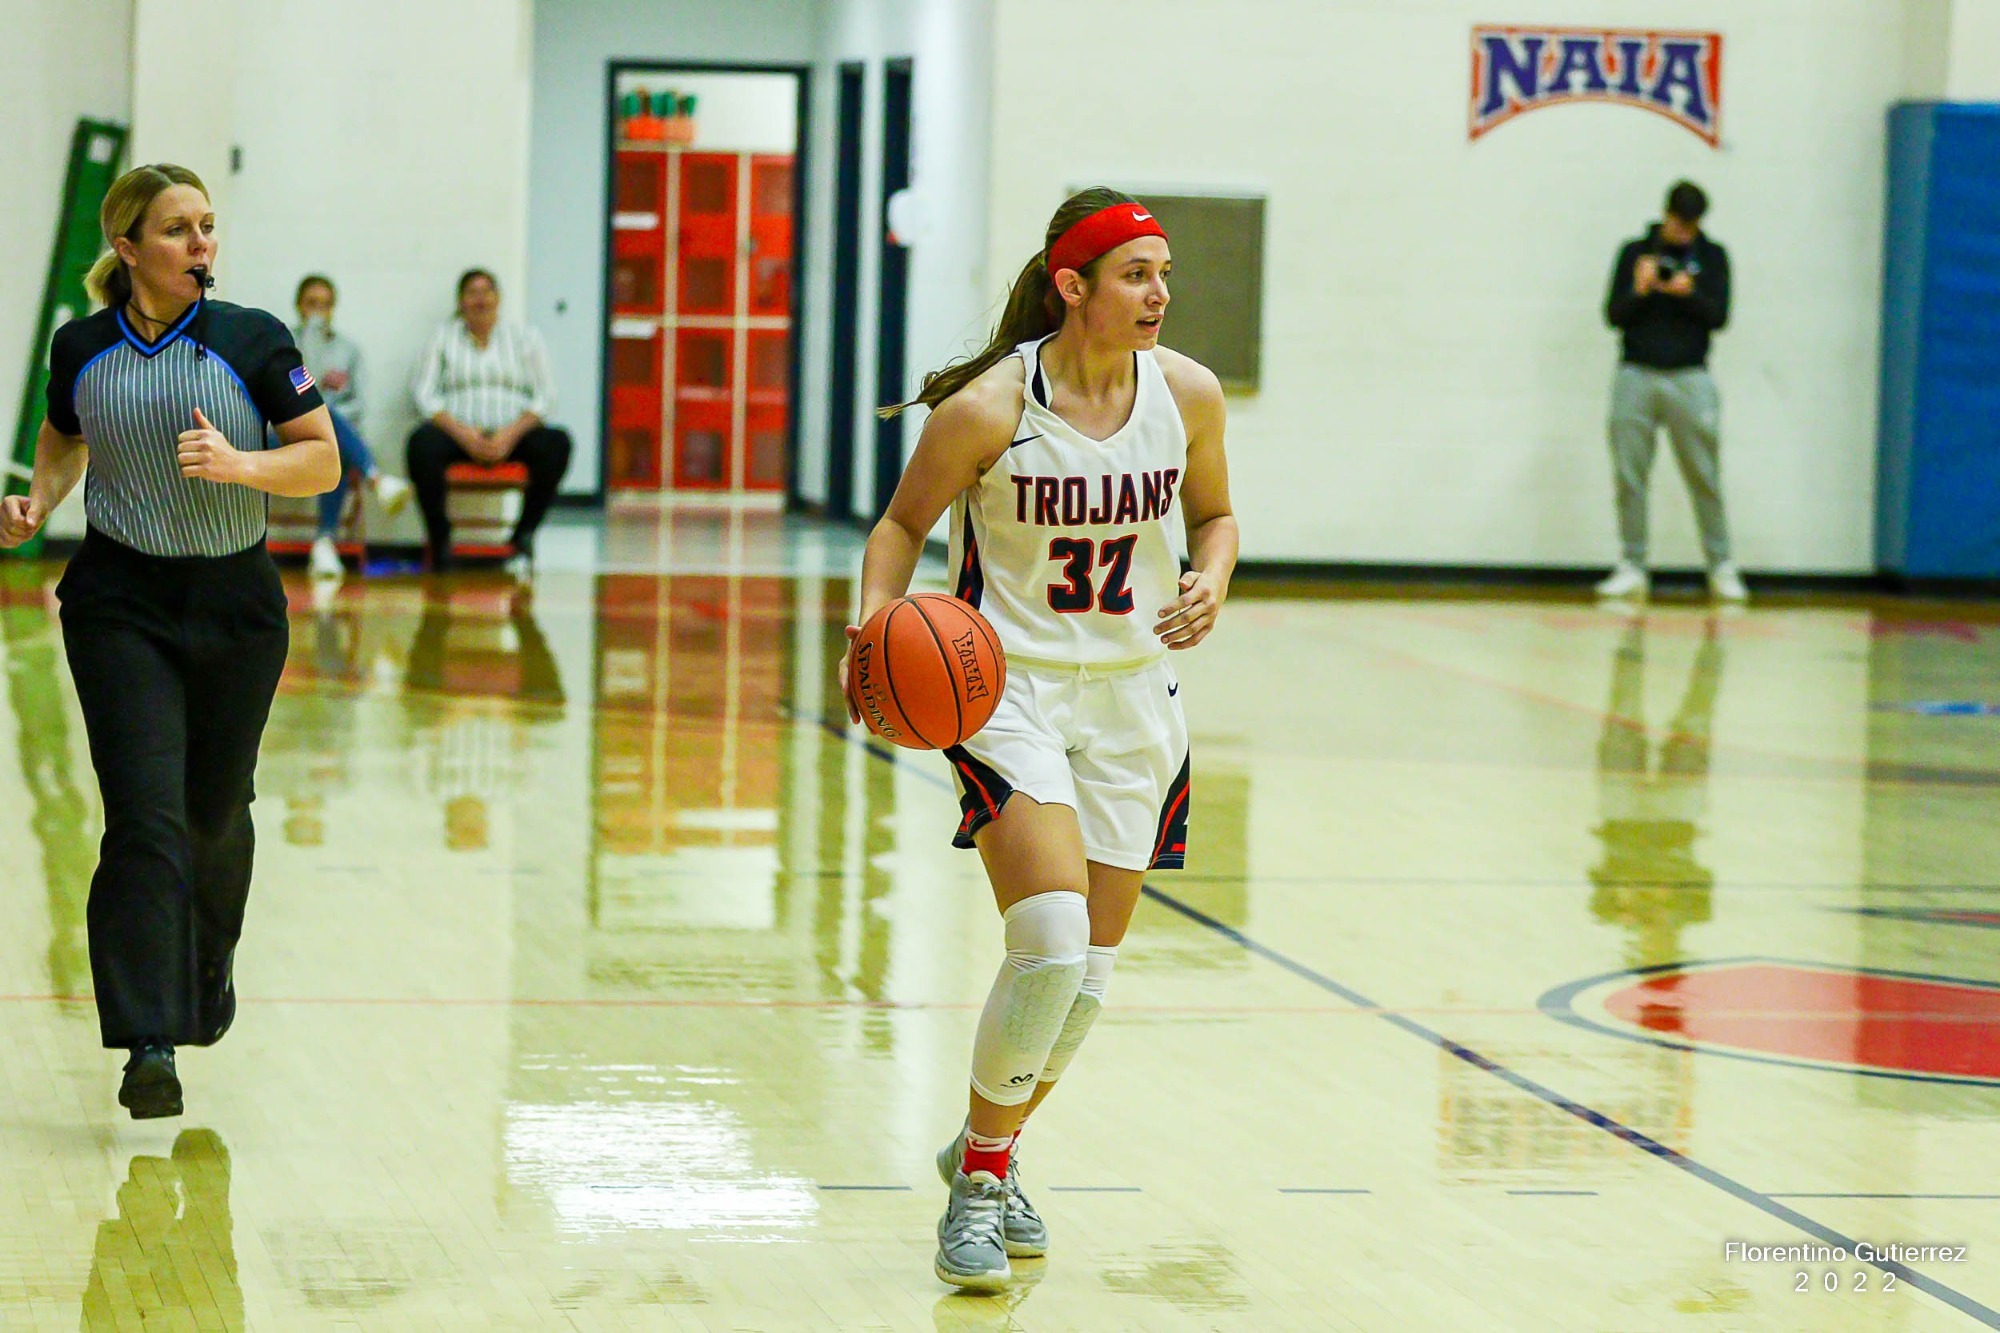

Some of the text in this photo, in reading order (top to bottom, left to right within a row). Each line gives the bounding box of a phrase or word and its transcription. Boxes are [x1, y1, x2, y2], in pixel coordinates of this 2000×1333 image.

[1480, 36, 1708, 123] NAIA
[1010, 468, 1179, 526] TROJANS
[1047, 533, 1138, 615] 32
[858, 641, 901, 738] SPALDING
[952, 631, 989, 703] NAIA
